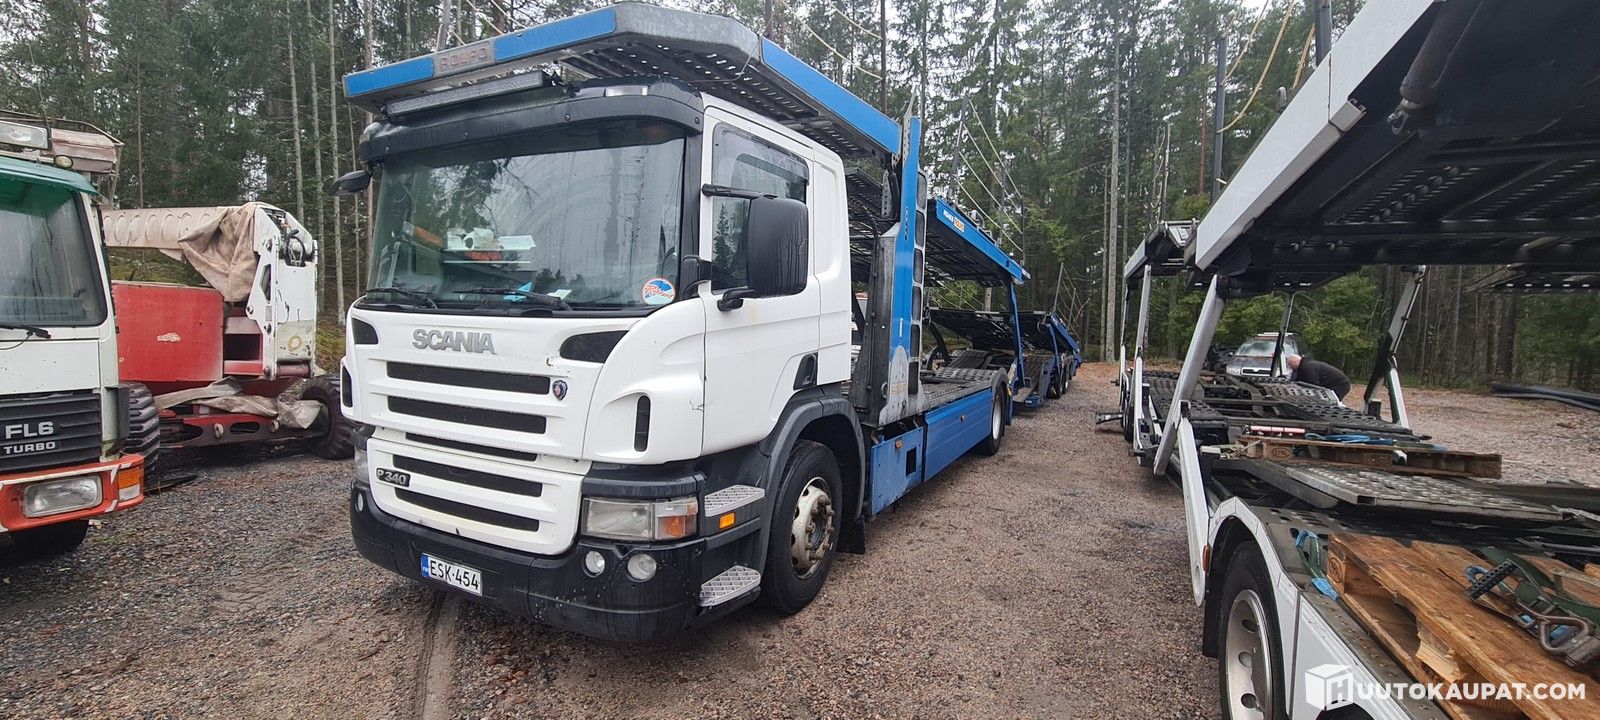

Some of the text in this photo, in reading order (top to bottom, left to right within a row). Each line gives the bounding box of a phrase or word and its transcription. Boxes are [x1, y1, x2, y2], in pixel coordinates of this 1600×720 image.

[412, 328, 497, 355] SCANIA
[5, 421, 54, 439] FL6
[3, 441, 56, 455] TURBO
[385, 471, 407, 485] 340
[430, 560, 479, 590] ESK-454
